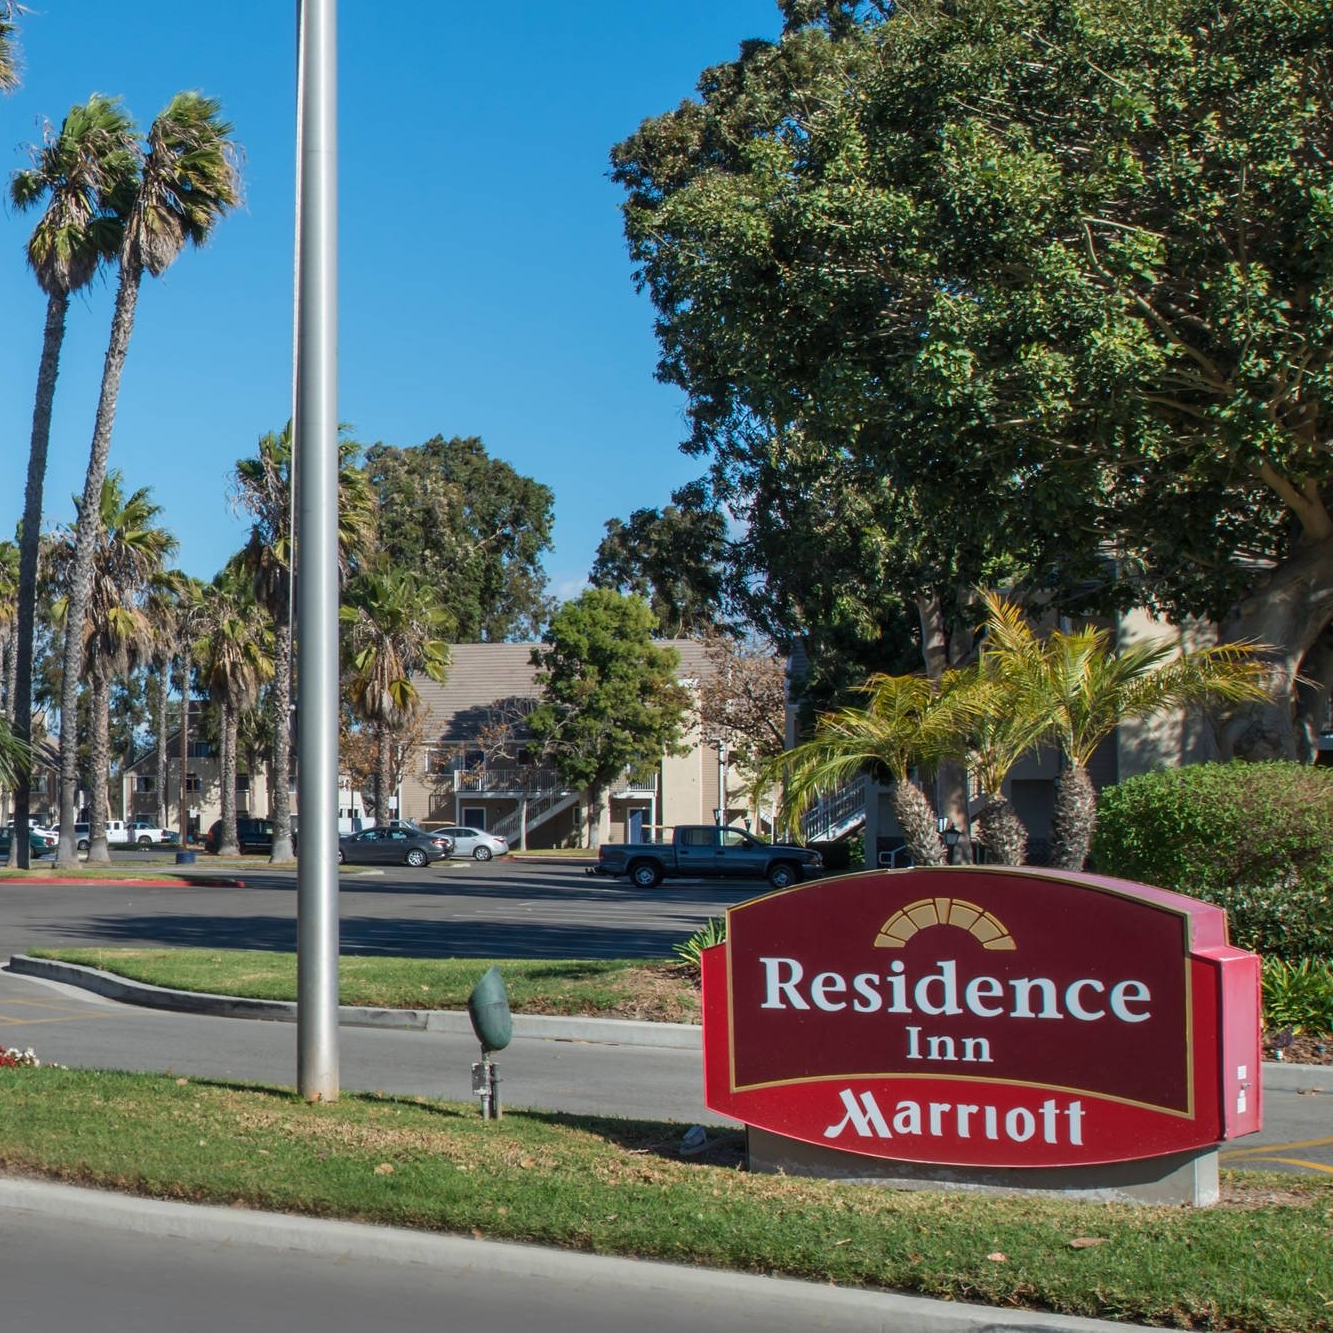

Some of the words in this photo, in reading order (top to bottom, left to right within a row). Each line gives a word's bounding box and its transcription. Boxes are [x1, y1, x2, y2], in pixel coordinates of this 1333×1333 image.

[759, 957, 1152, 1023] Residence
[905, 1026, 995, 1063] Inn
[823, 1088, 1087, 1146] Marriott
